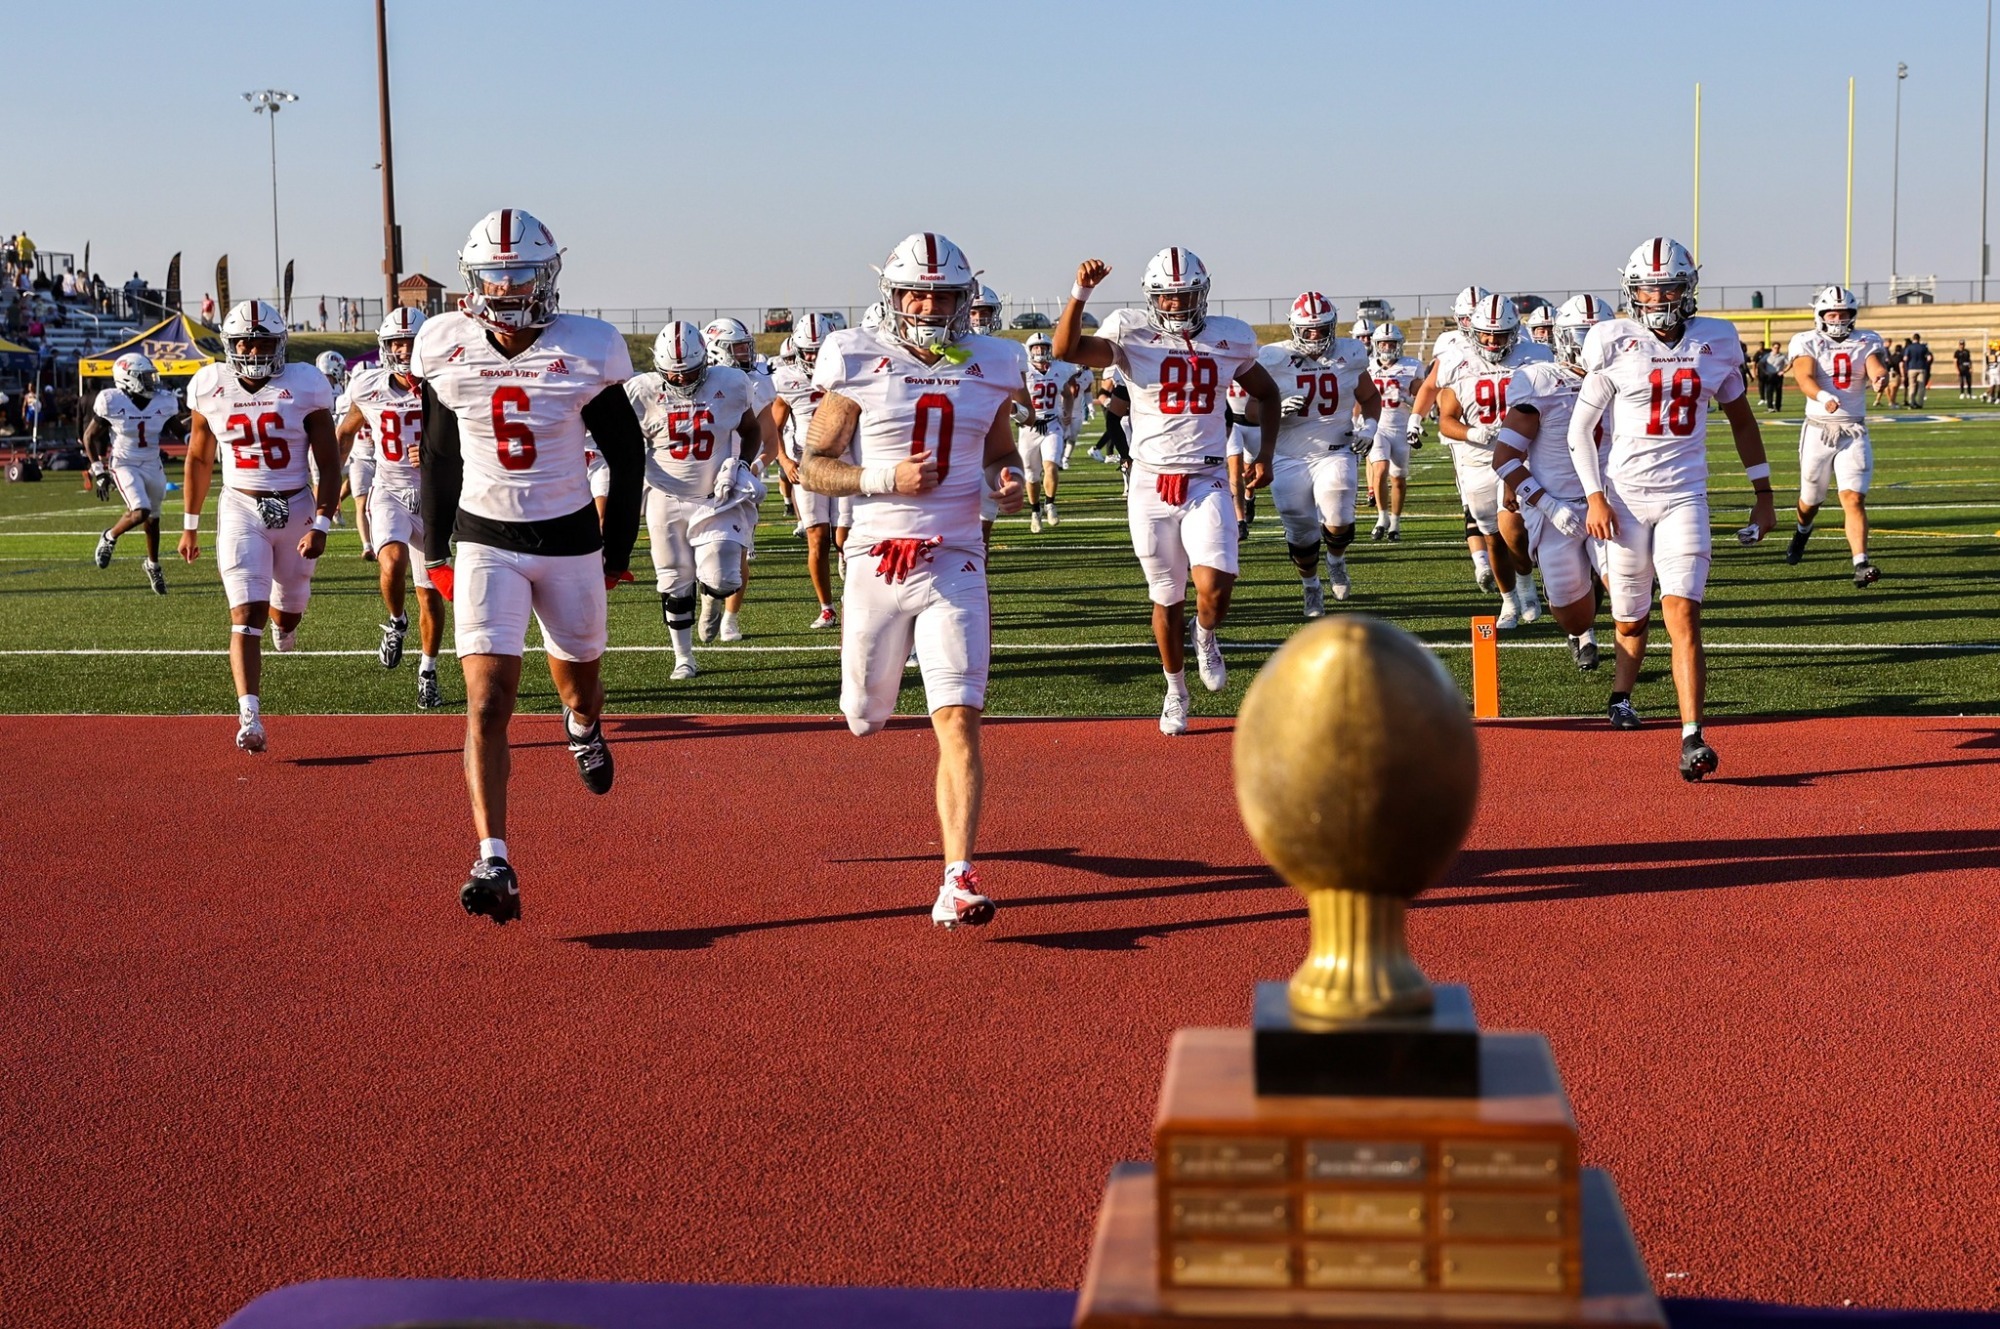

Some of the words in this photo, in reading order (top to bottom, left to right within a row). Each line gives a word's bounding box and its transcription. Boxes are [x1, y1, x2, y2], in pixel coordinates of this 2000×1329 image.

[480, 369, 513, 377] GRAND
[515, 369, 540, 378] VIEW
[904, 376, 936, 384] GRAND
[936, 377, 960, 386] VIEW
[1159, 356, 1218, 414] 88
[1296, 373, 1339, 417] 79
[1833, 353, 1852, 390] 0
[1032, 382, 1057, 409] 29
[1646, 368, 1701, 436] 18
[137, 421, 147, 448] 1
[227, 412, 291, 470] 26
[491, 386, 538, 470] 6
[668, 410, 714, 461] 56
[911, 393, 954, 485] 0
